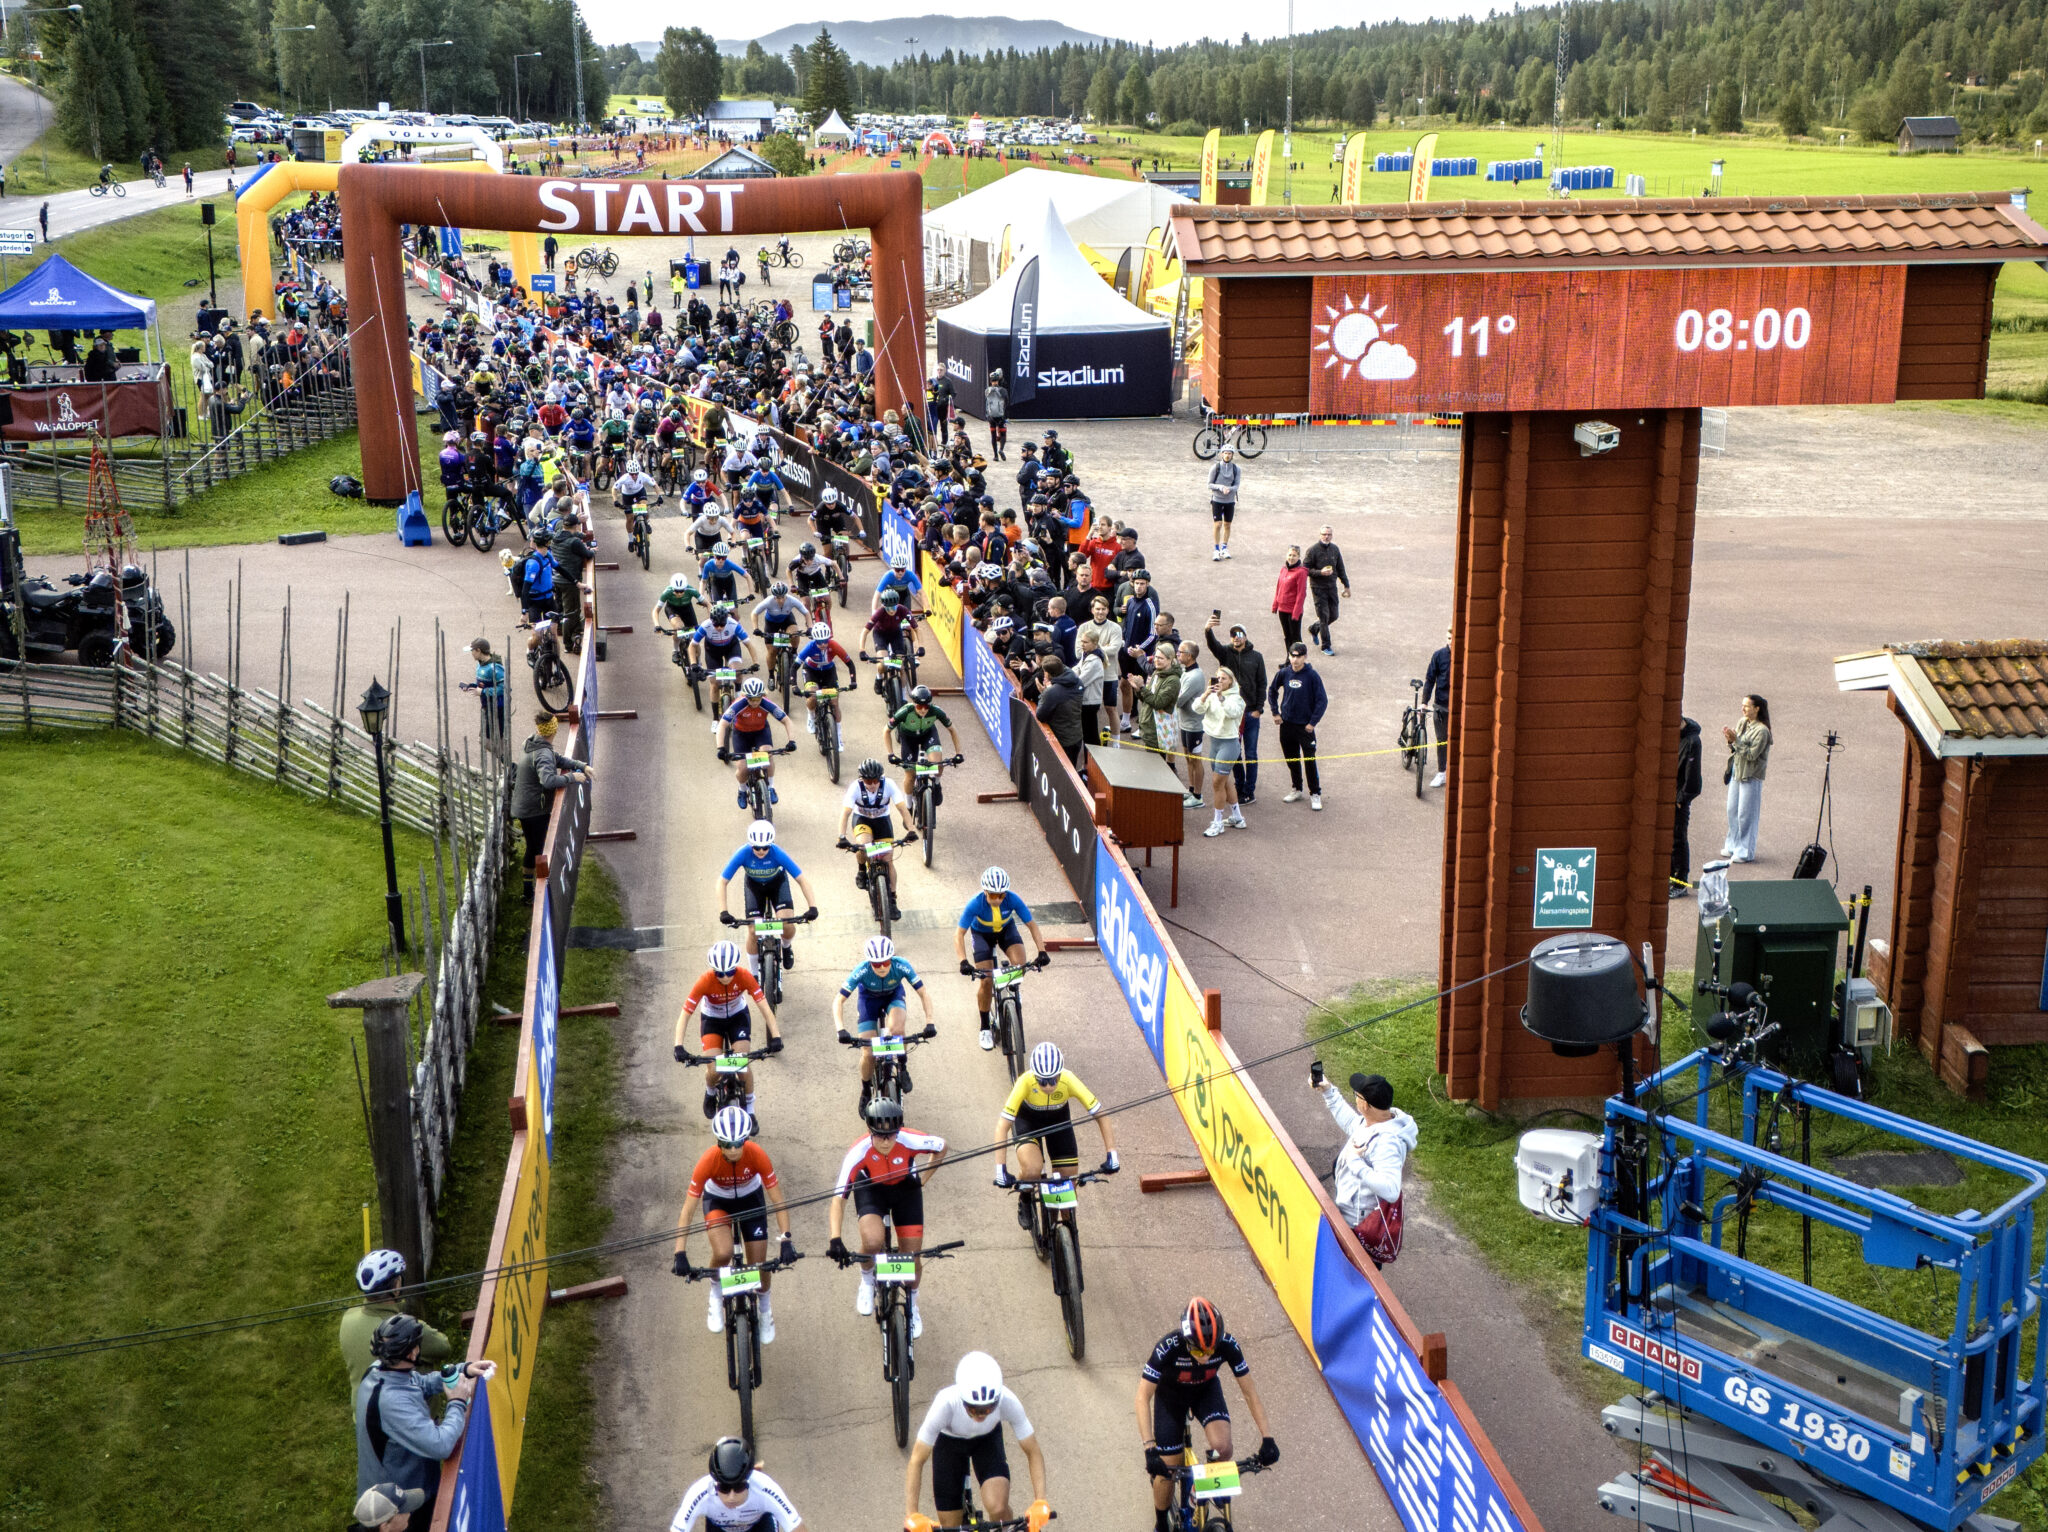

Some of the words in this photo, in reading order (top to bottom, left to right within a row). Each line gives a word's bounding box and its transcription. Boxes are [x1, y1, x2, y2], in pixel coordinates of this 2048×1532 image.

[389, 130, 453, 138] VOLVO
[1205, 151, 1213, 186] DHL
[1256, 151, 1266, 187] DHL
[1347, 158, 1357, 201] DHL
[1415, 158, 1427, 201] DHL
[538, 180, 745, 233] START
[1017, 303, 1033, 378] stadium
[1444, 314, 1516, 358] 11°
[1676, 307, 1811, 352] 08:00
[947, 357, 972, 383] stadium
[1038, 364, 1124, 388] stadium
[34, 419, 99, 432] VASALOPPET
[825, 481, 863, 517] LVO
[1032, 752, 1081, 853] VOLVO
[1100, 878, 1164, 1047] ahlsell
[727, 1058, 738, 1066] 54
[1055, 1194, 1062, 1204] 4
[1221, 1104, 1290, 1261] preem
[734, 1273, 747, 1285] 55
[890, 1263, 902, 1273] 19
[1155, 1334, 1180, 1361] ALPE
[1590, 1345, 1625, 1371] 1535760
[1614, 1328, 1697, 1376] CRAMO
[1723, 1375, 1772, 1415] GS
[1778, 1401, 1871, 1463] 1930
[1213, 1477, 1221, 1489] 5
